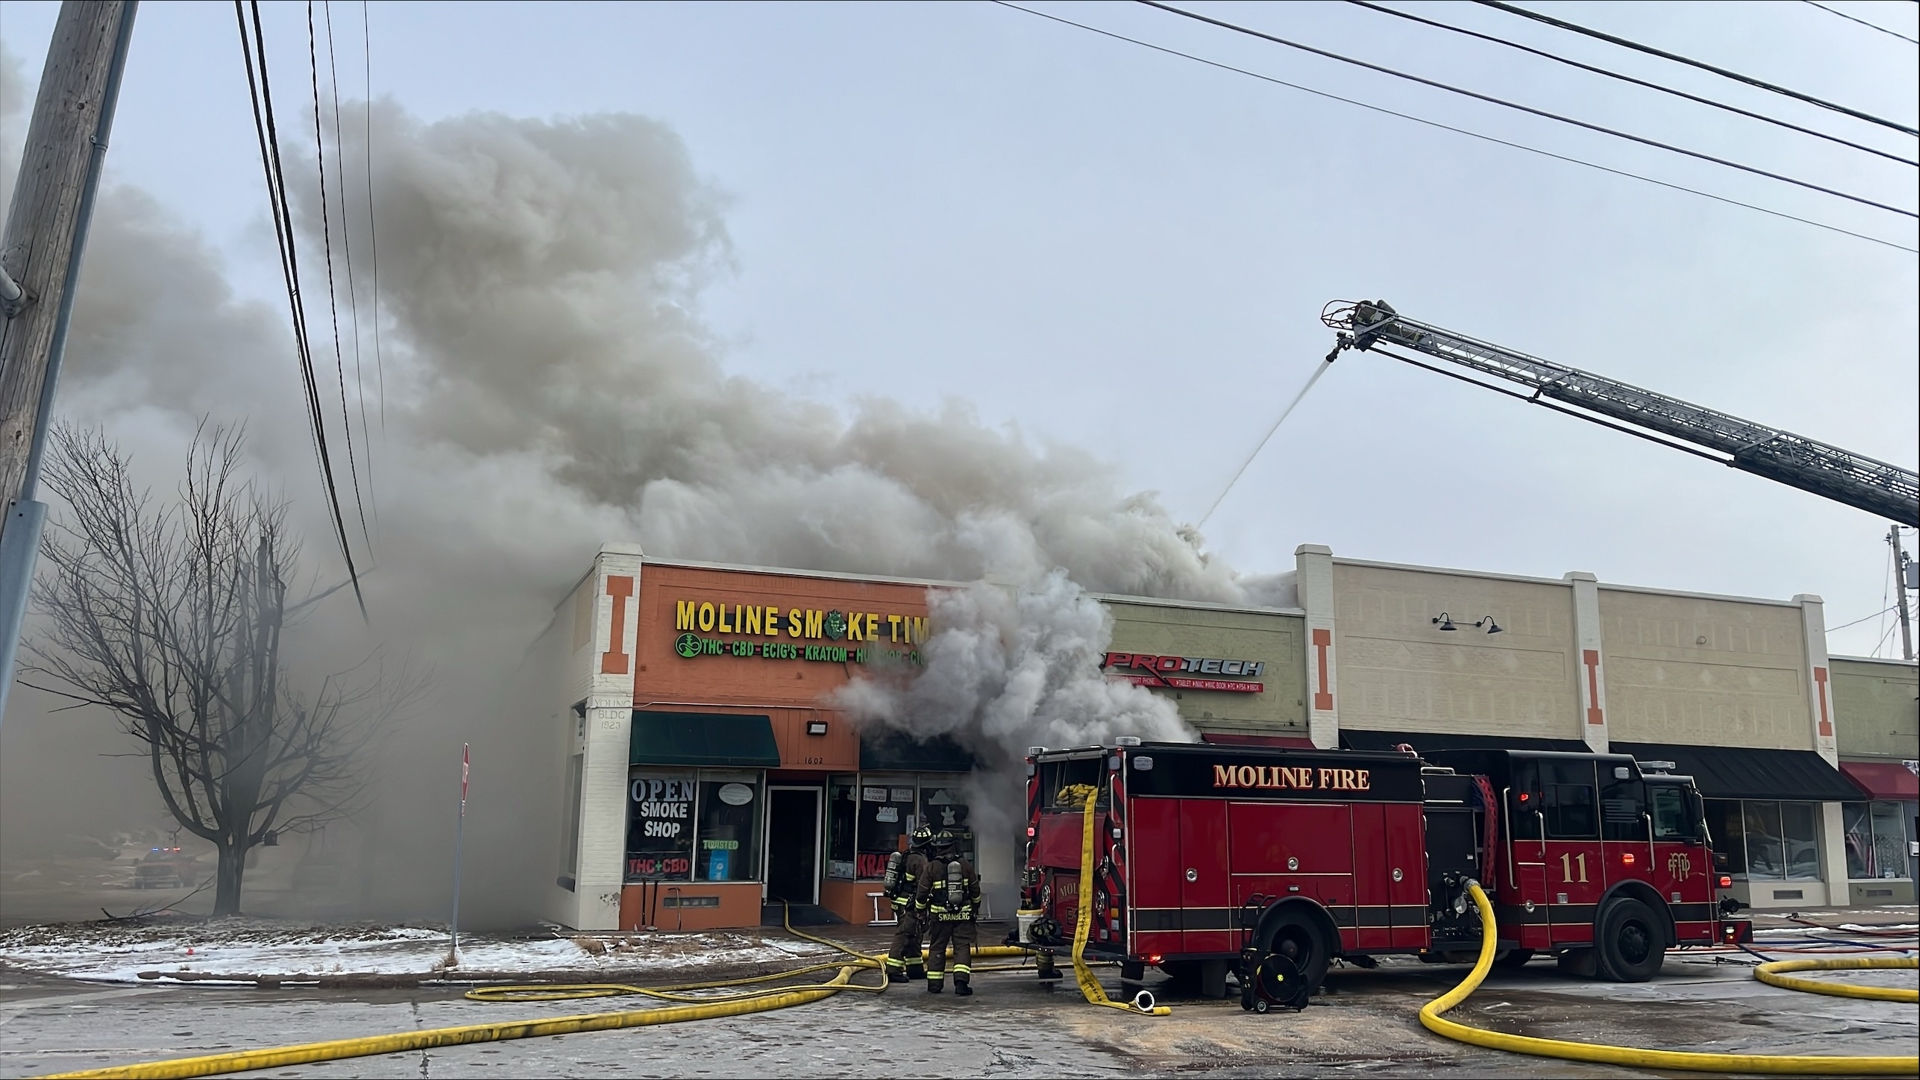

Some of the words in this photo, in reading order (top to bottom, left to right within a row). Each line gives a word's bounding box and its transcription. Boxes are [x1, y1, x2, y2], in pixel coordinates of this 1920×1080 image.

[676, 600, 779, 636] MOLINE
[702, 639, 724, 655] THC
[732, 641, 755, 657] CBD
[762, 643, 797, 660] ECIG'S
[805, 645, 847, 662] KRATOM
[1104, 652, 1264, 679] PROTECH
[602, 721, 621, 730] 1923
[804, 757, 823, 765] 1602
[1213, 764, 1314, 789] MOLINE
[1317, 767, 1371, 791] FIRE
[631, 780, 695, 802] OPEN
[640, 801, 688, 818] SMOKE
[644, 820, 681, 838] SHOP
[703, 840, 739, 850] TWISTED
[1559, 853, 1590, 883] 11
